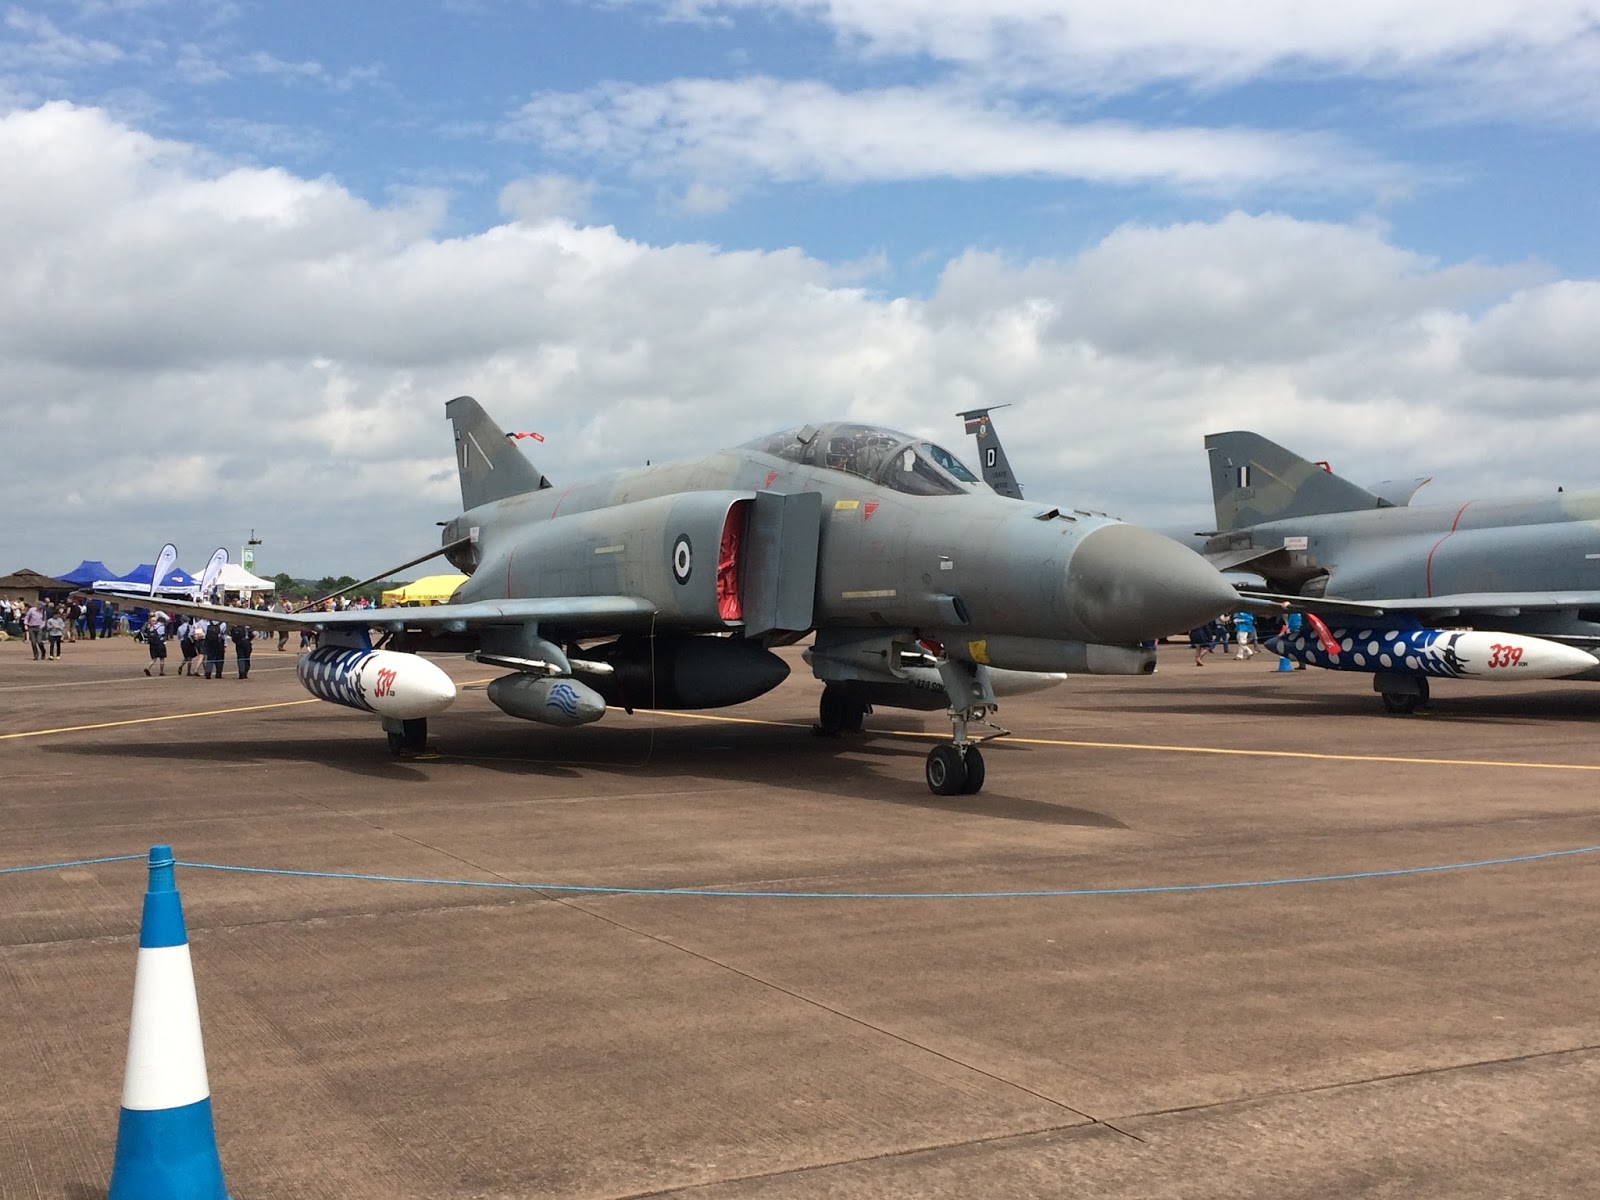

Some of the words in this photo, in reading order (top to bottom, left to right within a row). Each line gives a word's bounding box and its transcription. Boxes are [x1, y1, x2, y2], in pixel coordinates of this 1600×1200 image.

[987, 448, 996, 467] D
[1488, 644, 1523, 668] 339
[374, 667, 397, 698] 339
